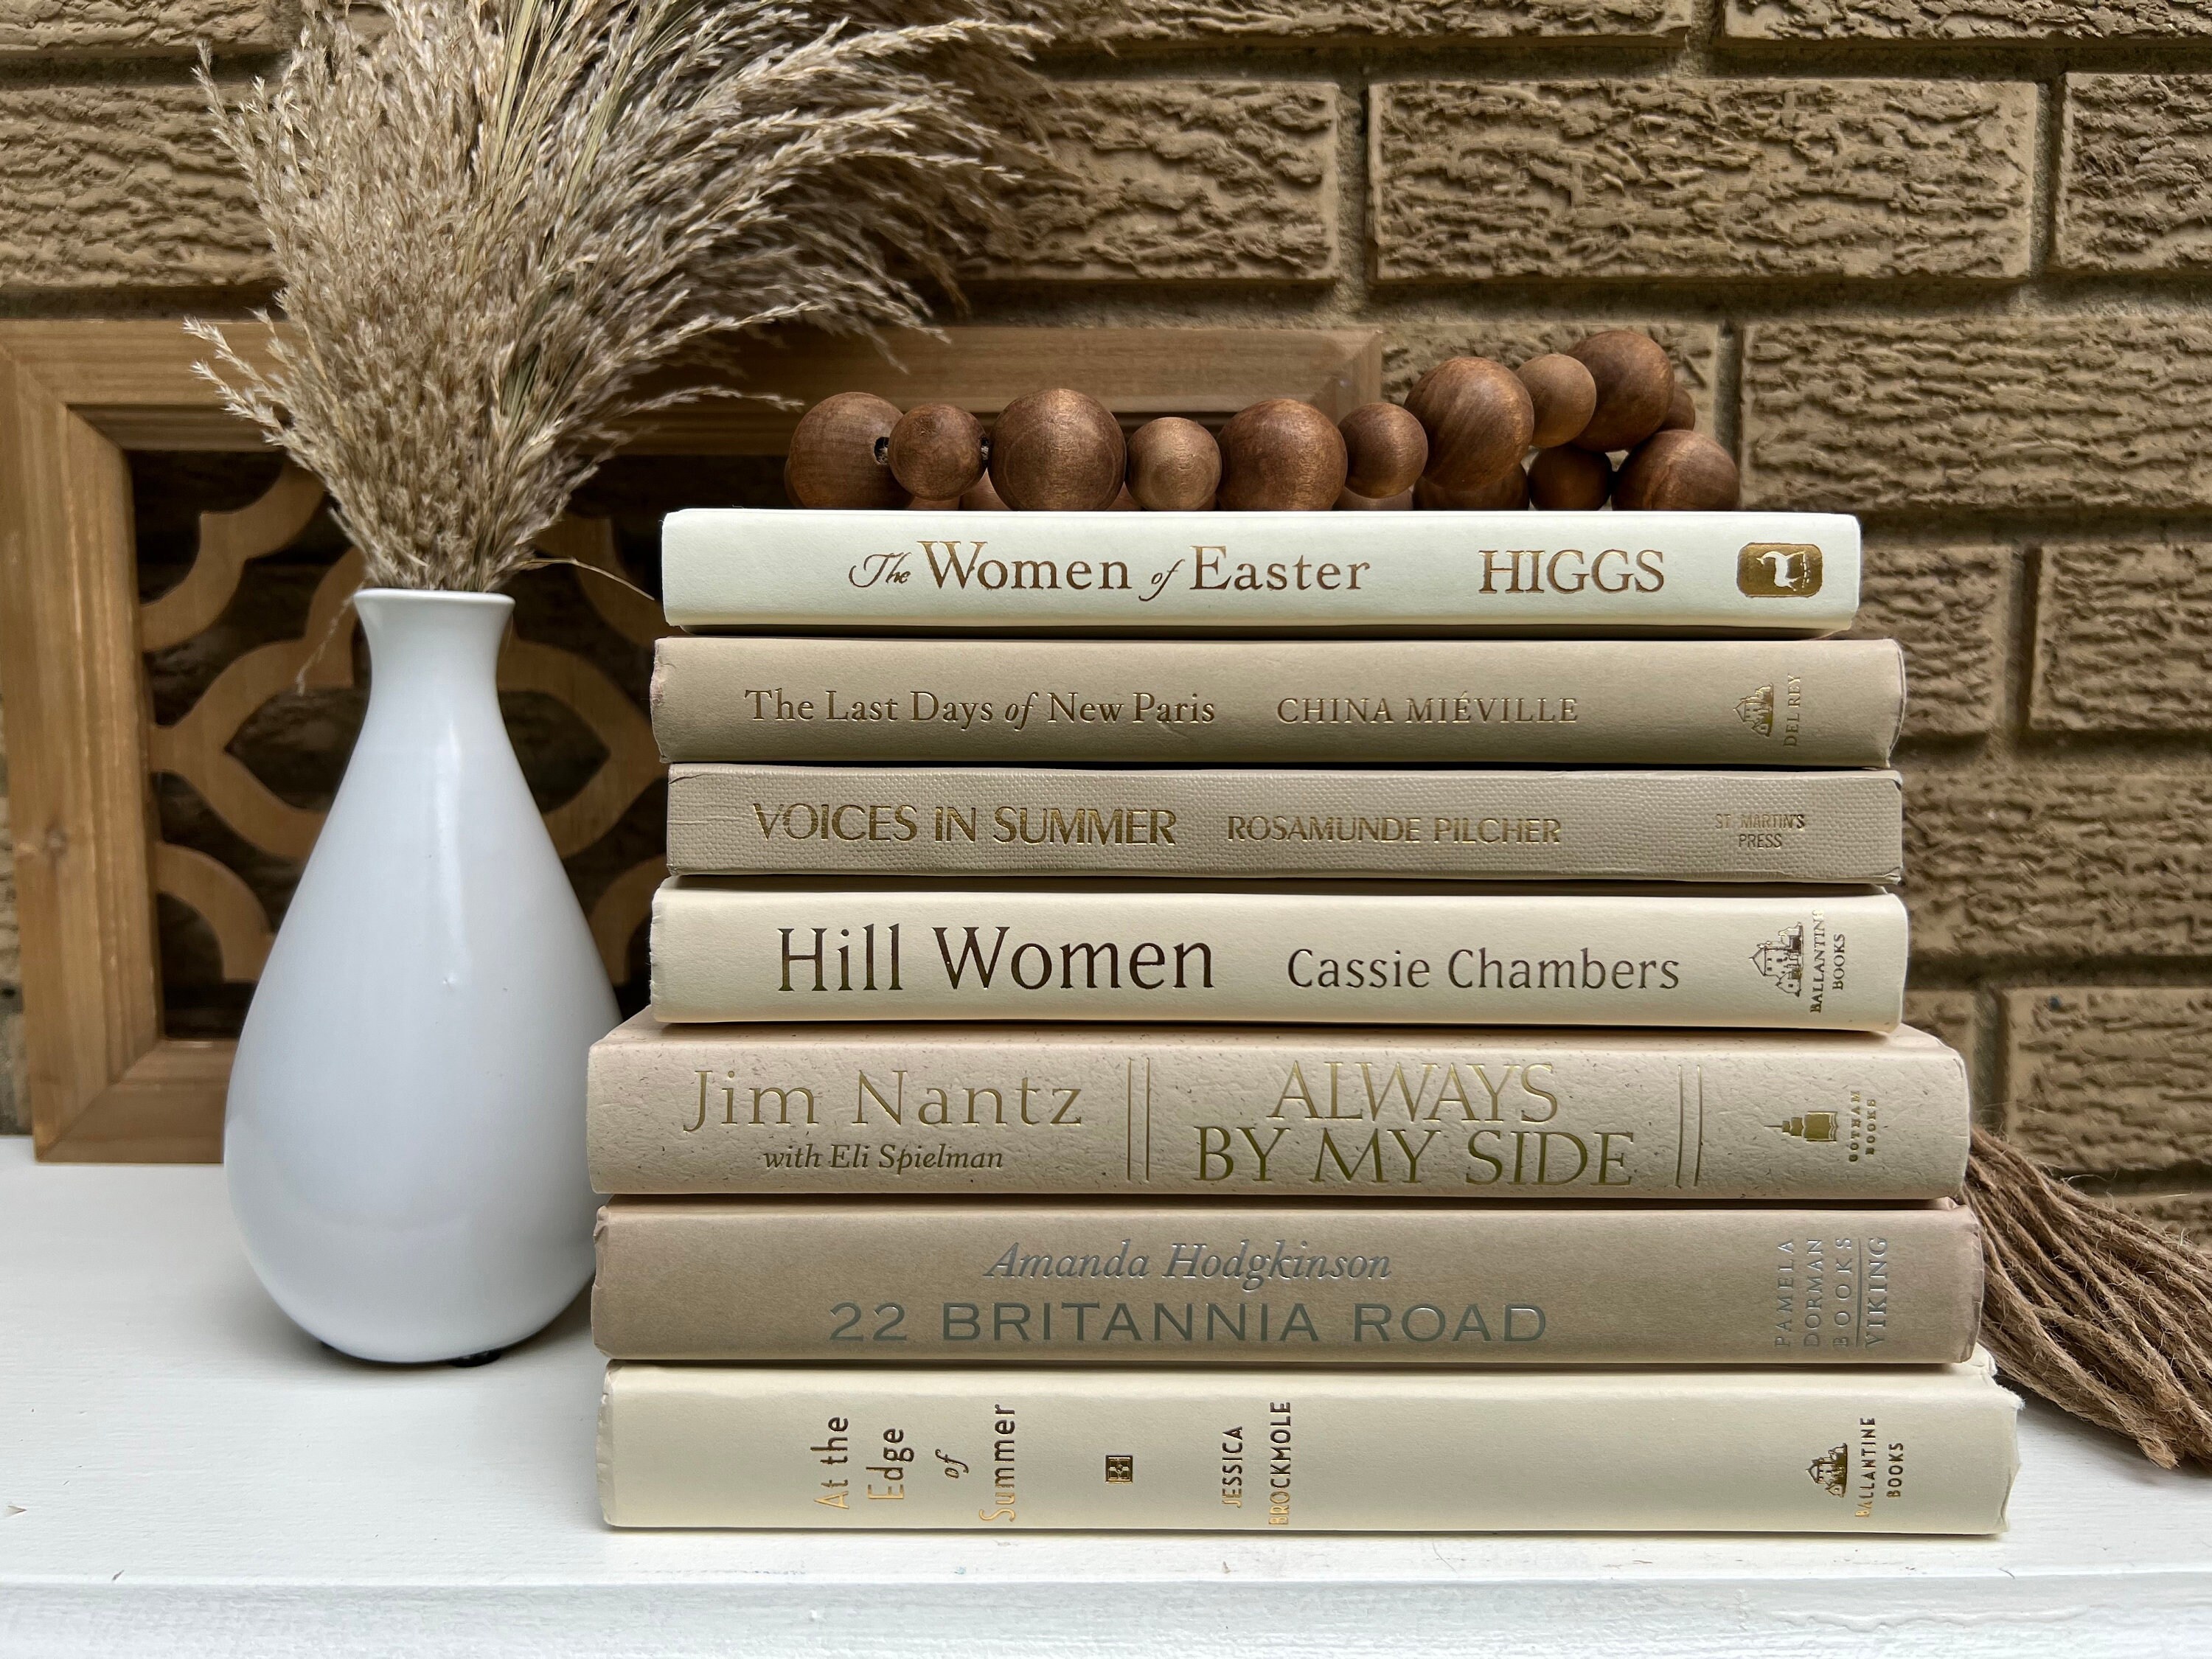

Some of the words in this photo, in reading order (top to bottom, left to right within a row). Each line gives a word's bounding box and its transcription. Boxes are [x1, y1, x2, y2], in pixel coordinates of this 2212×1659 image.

[849, 552, 910, 588] The
[917, 540, 1130, 590] Women
[1138, 558, 1185, 602] of
[1189, 546, 1371, 591] Easter
[1478, 549, 1665, 595] HIGGS
[745, 689, 814, 722] The
[826, 690, 895, 723] Last
[910, 691, 993, 730] Days
[1005, 692, 1039, 731] of
[1048, 692, 1124, 723] New
[1133, 692, 1215, 724] Paris
[1276, 698, 1394, 725] CHINA
[1405, 690, 1579, 725] MIÉVILLE
[1787, 673, 1801, 701] REY
[1783, 713, 1800, 747] DEL
[754, 803, 917, 844] VOICES
[935, 807, 977, 843] IN
[993, 806, 1177, 846] SUMMER
[1228, 815, 1421, 844] ROSAMUNDE
[1433, 818, 1562, 845] PILCHER
[1738, 833, 1782, 849] PRESS
[777, 923, 903, 992] Hill
[932, 926, 1214, 990] Women
[1287, 949, 1430, 989] Cassie
[1448, 947, 1680, 990] Chambers
[1832, 933, 1845, 990] BOOKS
[683, 1070, 818, 1133] Jim
[851, 1070, 1082, 1127] Nantz
[1267, 1060, 1558, 1124] ALWAYS
[1848, 1091, 1861, 1162] GOTHAM
[1865, 1099, 1877, 1155] BOOKS
[763, 1144, 821, 1169] with
[829, 1144, 870, 1169] Eli
[878, 1144, 1004, 1175] Spielman
[1194, 1126, 1289, 1182] BY
[1310, 1128, 1441, 1184] MY
[1466, 1130, 1633, 1186] SIDE
[983, 1238, 1150, 1280] Amanda
[1161, 1240, 1391, 1292] Hodgkinson
[1775, 1238, 1794, 1348] PAMELA
[1804, 1239, 1823, 1347] DORMAN
[1833, 1237, 1853, 1348] BOOKS
[1865, 1237, 1888, 1349] VIKING
[829, 1302, 907, 1342] 22
[942, 1302, 1320, 1343] BRITANNIA
[1354, 1303, 1547, 1343] ROAD
[810, 1416, 849, 1464] the
[866, 1427, 914, 1499] Edge
[935, 1449, 969, 1478] of
[978, 1404, 1015, 1522] Summer
[1222, 1426, 1243, 1509] JESSICA
[1268, 1402, 1290, 1525] BROCKMOLE
[1854, 1418, 1877, 1517] BALLANTINE
[814, 1480, 849, 1509] At
[1886, 1442, 1904, 1498] BOOKS
